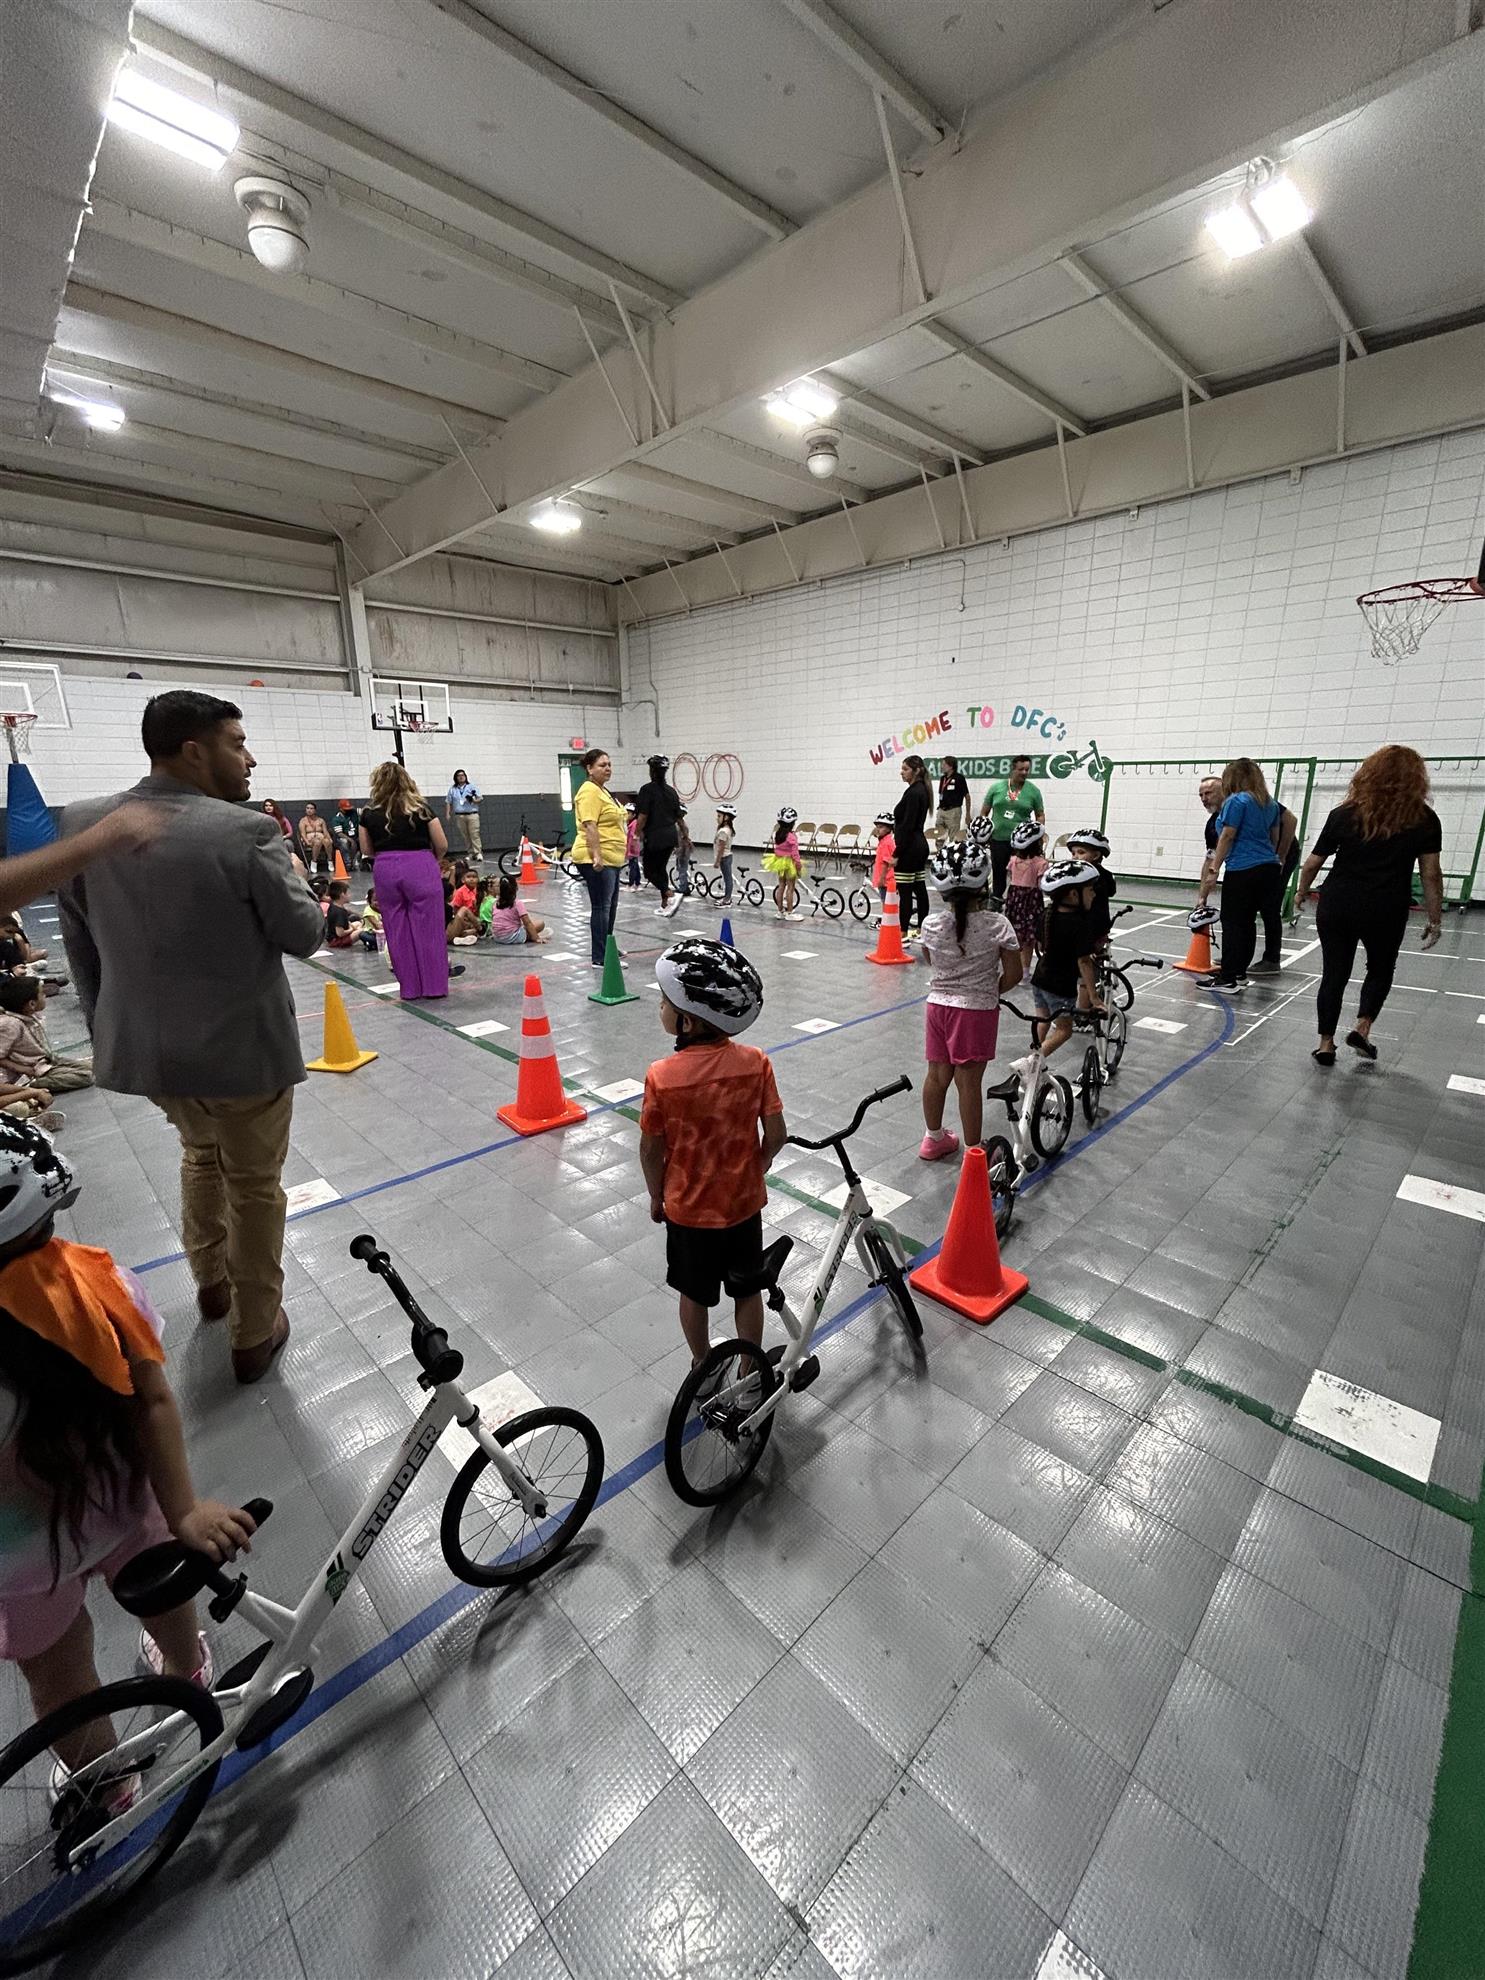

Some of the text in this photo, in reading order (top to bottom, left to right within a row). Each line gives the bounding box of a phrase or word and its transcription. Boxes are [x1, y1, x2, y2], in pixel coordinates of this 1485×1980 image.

[869, 710, 953, 766] WELCOME
[966, 705, 995, 729] TO
[957, 758, 996, 776] KIDS
[999, 756, 1041, 776] BE
[351, 1425, 442, 1561] STRIDER
